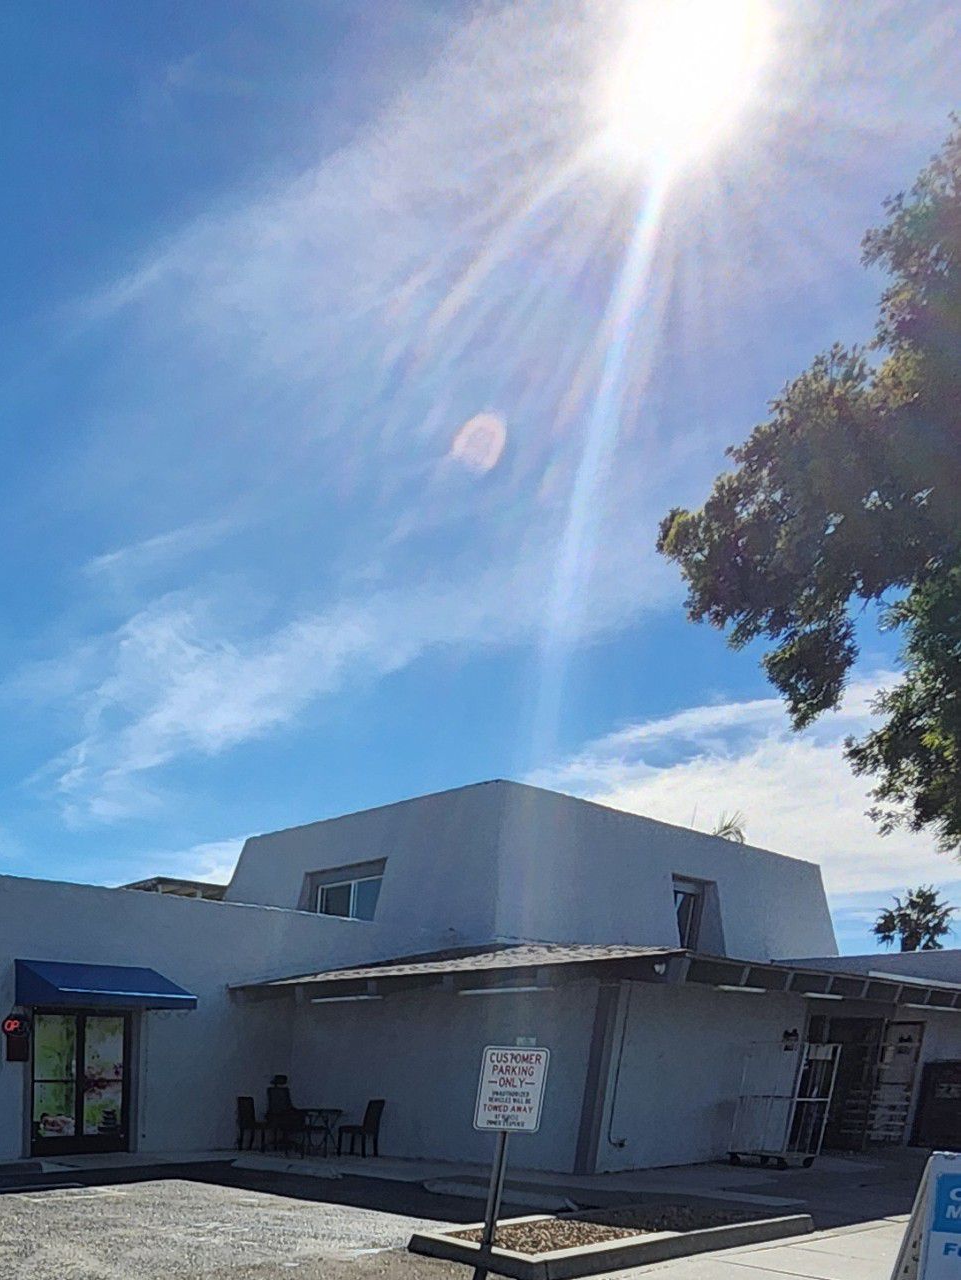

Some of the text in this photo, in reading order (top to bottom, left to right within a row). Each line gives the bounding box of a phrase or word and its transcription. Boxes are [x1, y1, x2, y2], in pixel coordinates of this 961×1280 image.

[4, 1019, 28, 1032] OP
[490, 1052, 542, 1065] CUSTOMER
[491, 1065, 535, 1077] PARKING
[498, 1077, 526, 1088] ONLY
[483, 1104, 534, 1114] TOWED AWAY
